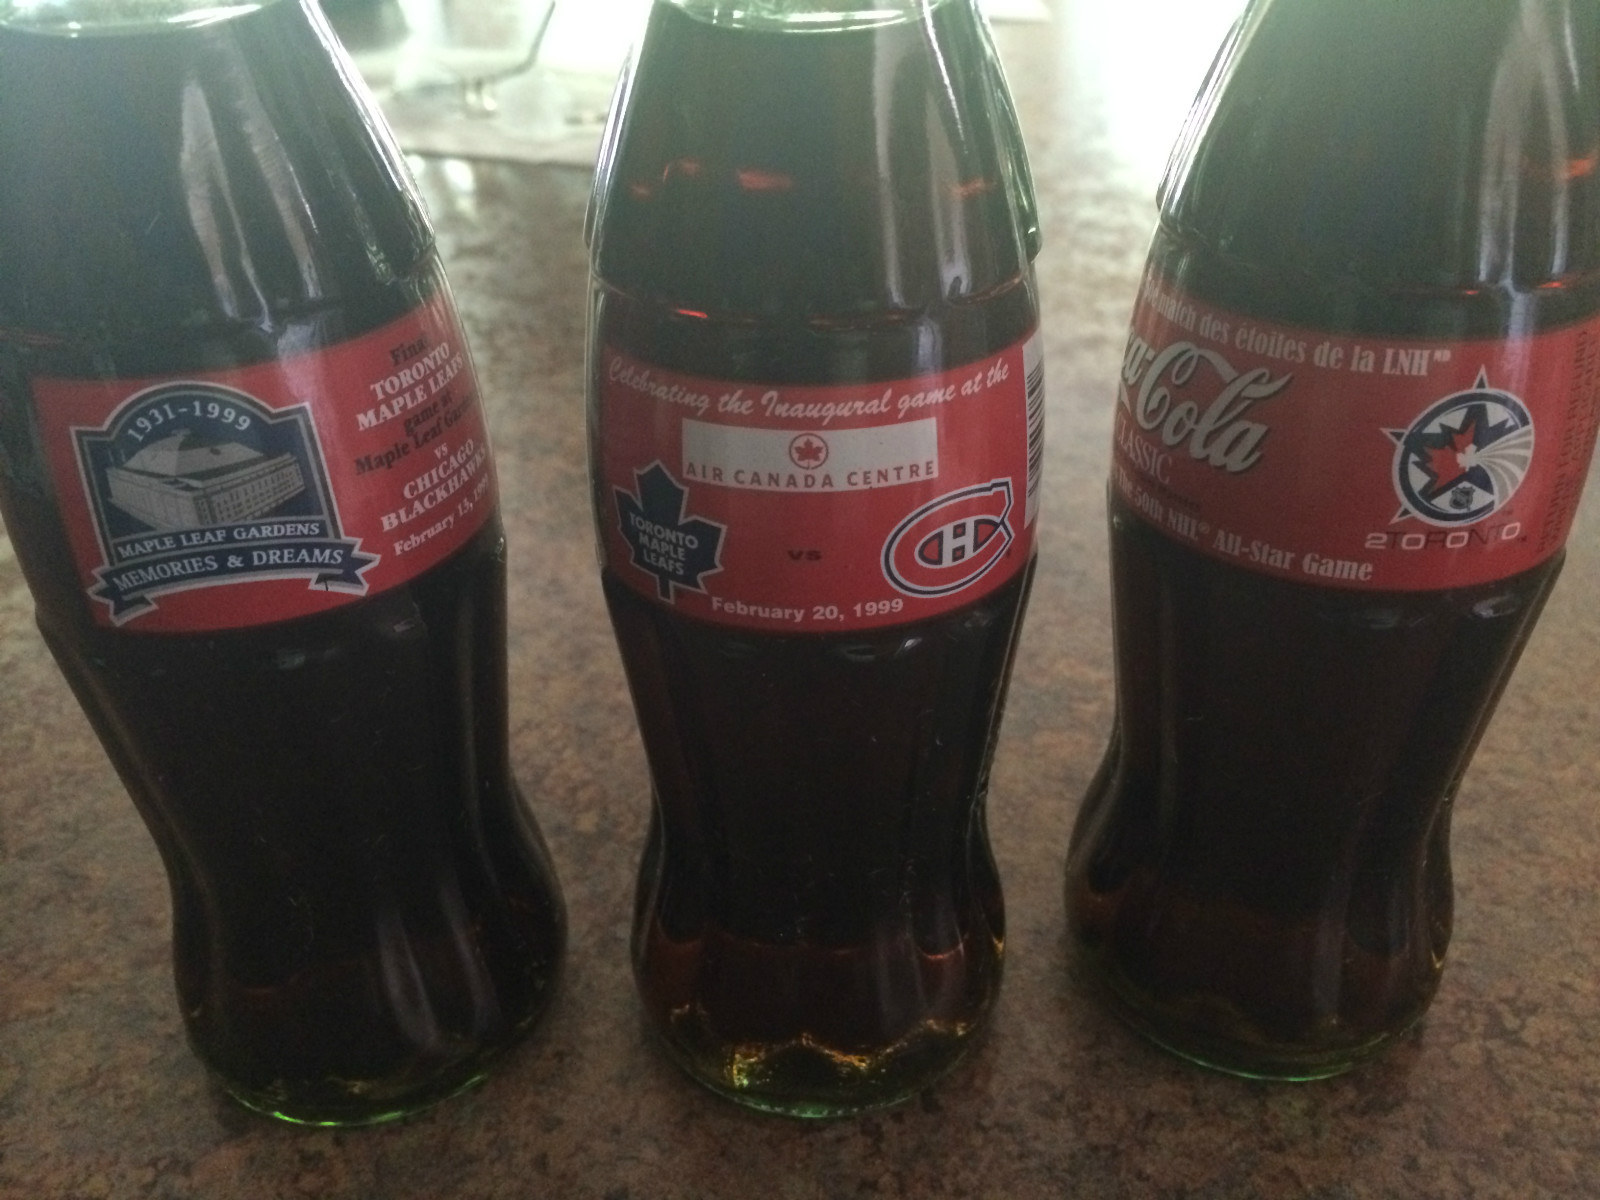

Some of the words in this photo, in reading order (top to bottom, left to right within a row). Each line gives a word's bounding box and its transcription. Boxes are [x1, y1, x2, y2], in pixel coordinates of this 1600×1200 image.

[390, 335, 427, 366] Fina
[1200, 318, 1229, 344] des
[1235, 322, 1306, 364] étoiles
[1313, 341, 1344, 369] de
[1350, 346, 1375, 373] la
[356, 384, 427, 431] MAPLE
[430, 352, 463, 393] LEAFS
[370, 342, 450, 400] TORONTO
[609, 356, 711, 415] Celebrating
[718, 390, 754, 416] the
[760, 388, 892, 426] Inaugural
[897, 384, 957, 419] game
[960, 375, 984, 397] at
[984, 358, 1010, 390] the
[128, 400, 251, 442] 1931-1999
[403, 401, 439, 437] game
[355, 442, 411, 475] Maple
[414, 424, 443, 447] Leaf
[403, 438, 474, 500] CHICAGO
[434, 443, 448, 459] vs
[380, 446, 486, 532] BLACKHAWKS
[686, 461, 724, 481] AIR
[733, 469, 834, 490] CANADA
[846, 459, 936, 488] CENTRE
[117, 537, 177, 559] MAPLE
[180, 529, 226, 547] LEAF
[233, 522, 320, 541] GARDENS
[393, 512, 455, 557] February
[629, 511, 699, 550] TORONTO
[640, 532, 687, 561] MAPLE
[113, 555, 219, 591] MEMORIES
[226, 554, 245, 569] &
[252, 548, 344, 566] DREAMS
[643, 550, 685, 576] LEAFS
[1213, 529, 1296, 570] All-Star
[1302, 552, 1373, 581] Game
[711, 596, 805, 622] February
[812, 605, 845, 621] 20,
[854, 598, 904, 618] 1999
